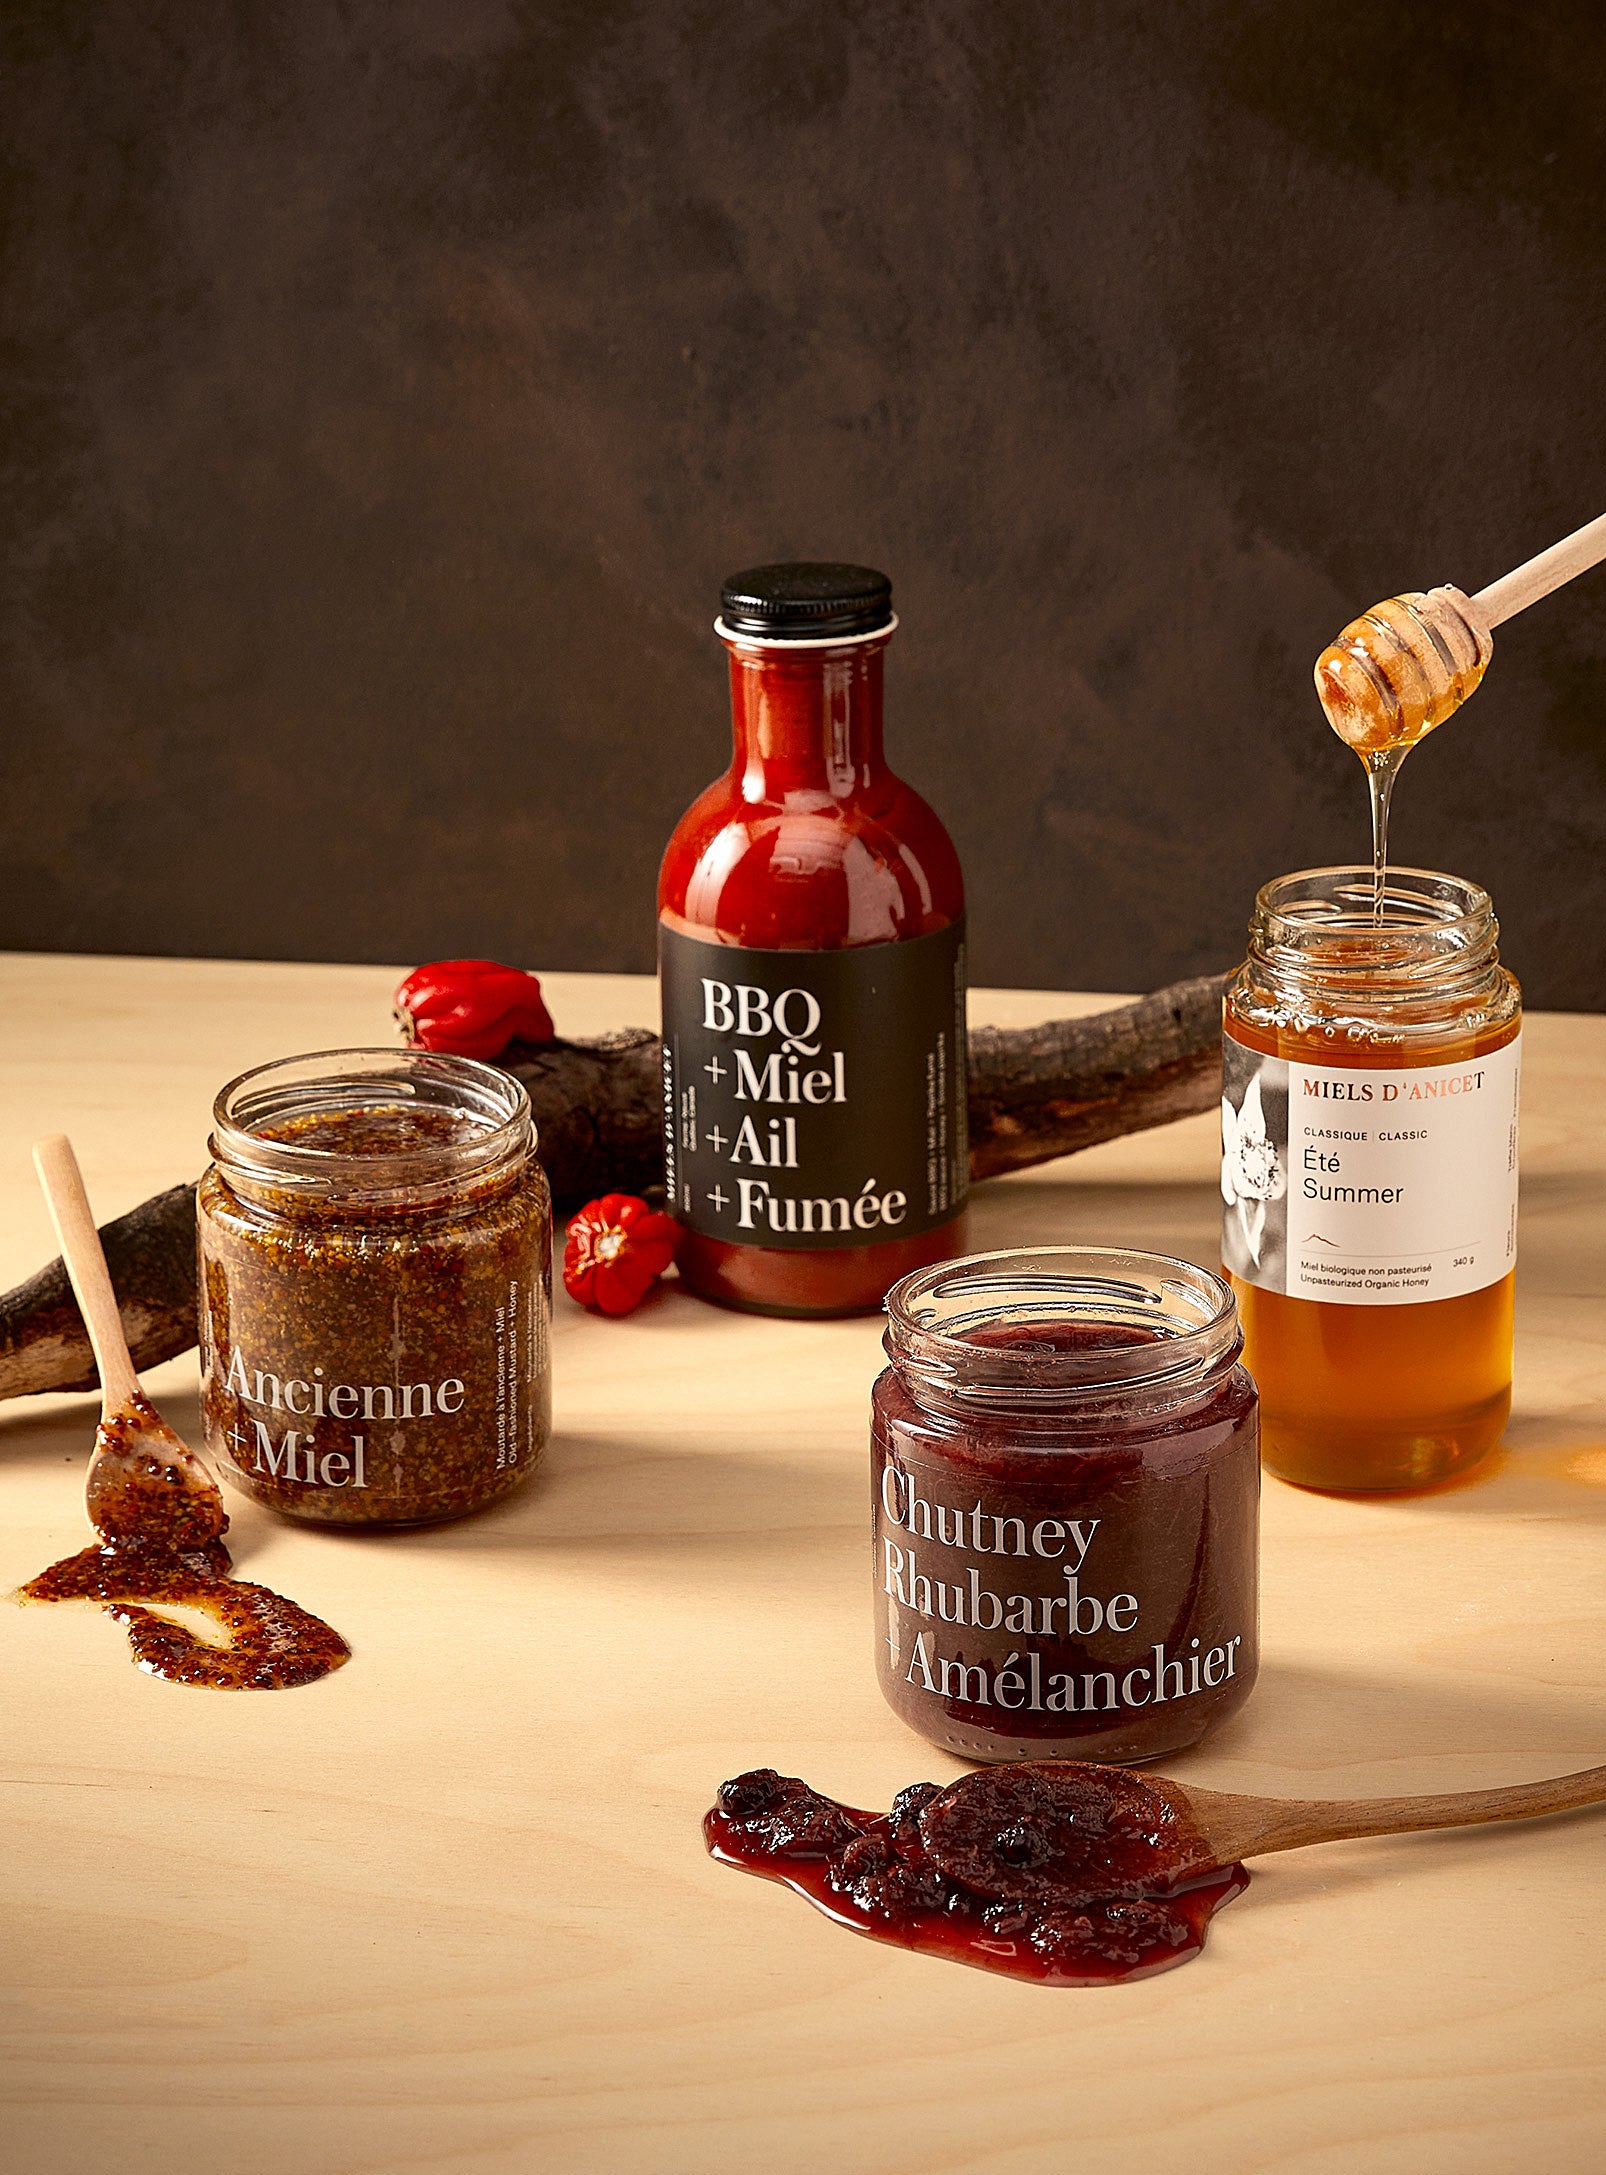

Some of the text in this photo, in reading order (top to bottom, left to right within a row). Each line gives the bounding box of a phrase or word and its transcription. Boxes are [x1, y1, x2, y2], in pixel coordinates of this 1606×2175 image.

[700, 977, 822, 1057] BBQ
[1303, 1078, 1374, 1102] MIELS
[1382, 1071, 1486, 1102] D'ANICET
[1303, 1127, 1428, 1141] CLASSIQUE CLASSIC
[1303, 1145, 1341, 1173] Été
[1303, 1178, 1404, 1204] Summer
[1300, 1261, 1433, 1277] Miel biologique non pasteurisé
[1300, 1273, 1430, 1290] Unpasteurized Organic Honey
[1452, 1258, 1468, 1267] 340
[507, 1280, 519, 1318] Honey
[495, 1306, 506, 1333] Miel
[496, 1345, 506, 1402] l'ancienne
[507, 1330, 518, 1379] Mustard
[223, 1344, 465, 1420] Ancienne
[507, 1380, 518, 1464] Old-fashioned
[496, 1413, 506, 1470] Moutarde
[881, 1464, 1101, 1575] Chutney
[882, 1534, 1138, 1636] Rhubarbe
